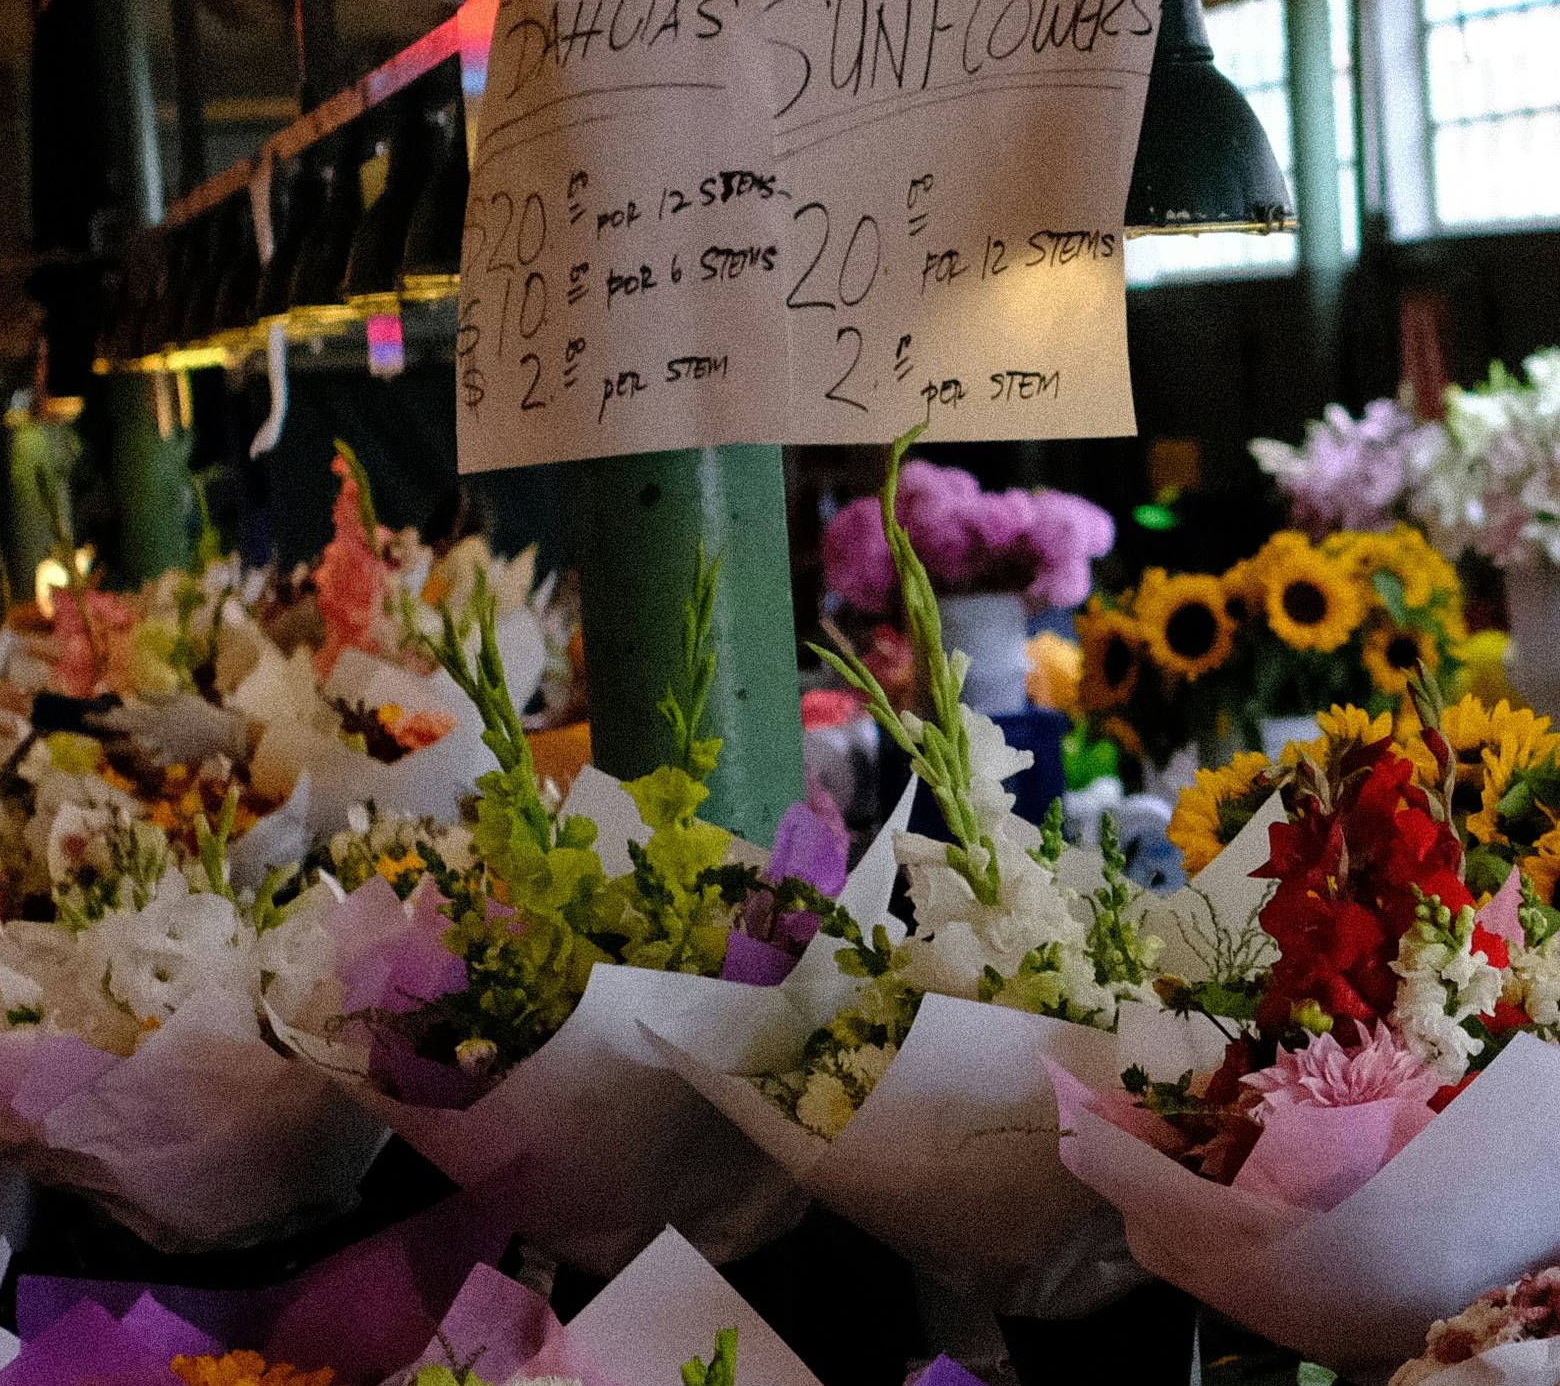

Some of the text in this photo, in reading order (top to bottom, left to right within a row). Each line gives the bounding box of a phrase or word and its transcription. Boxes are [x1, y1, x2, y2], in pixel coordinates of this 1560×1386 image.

[1026, 229, 1115, 268] STEMS
[666, 356, 728, 382] STEM
[990, 369, 1060, 402] STEM
